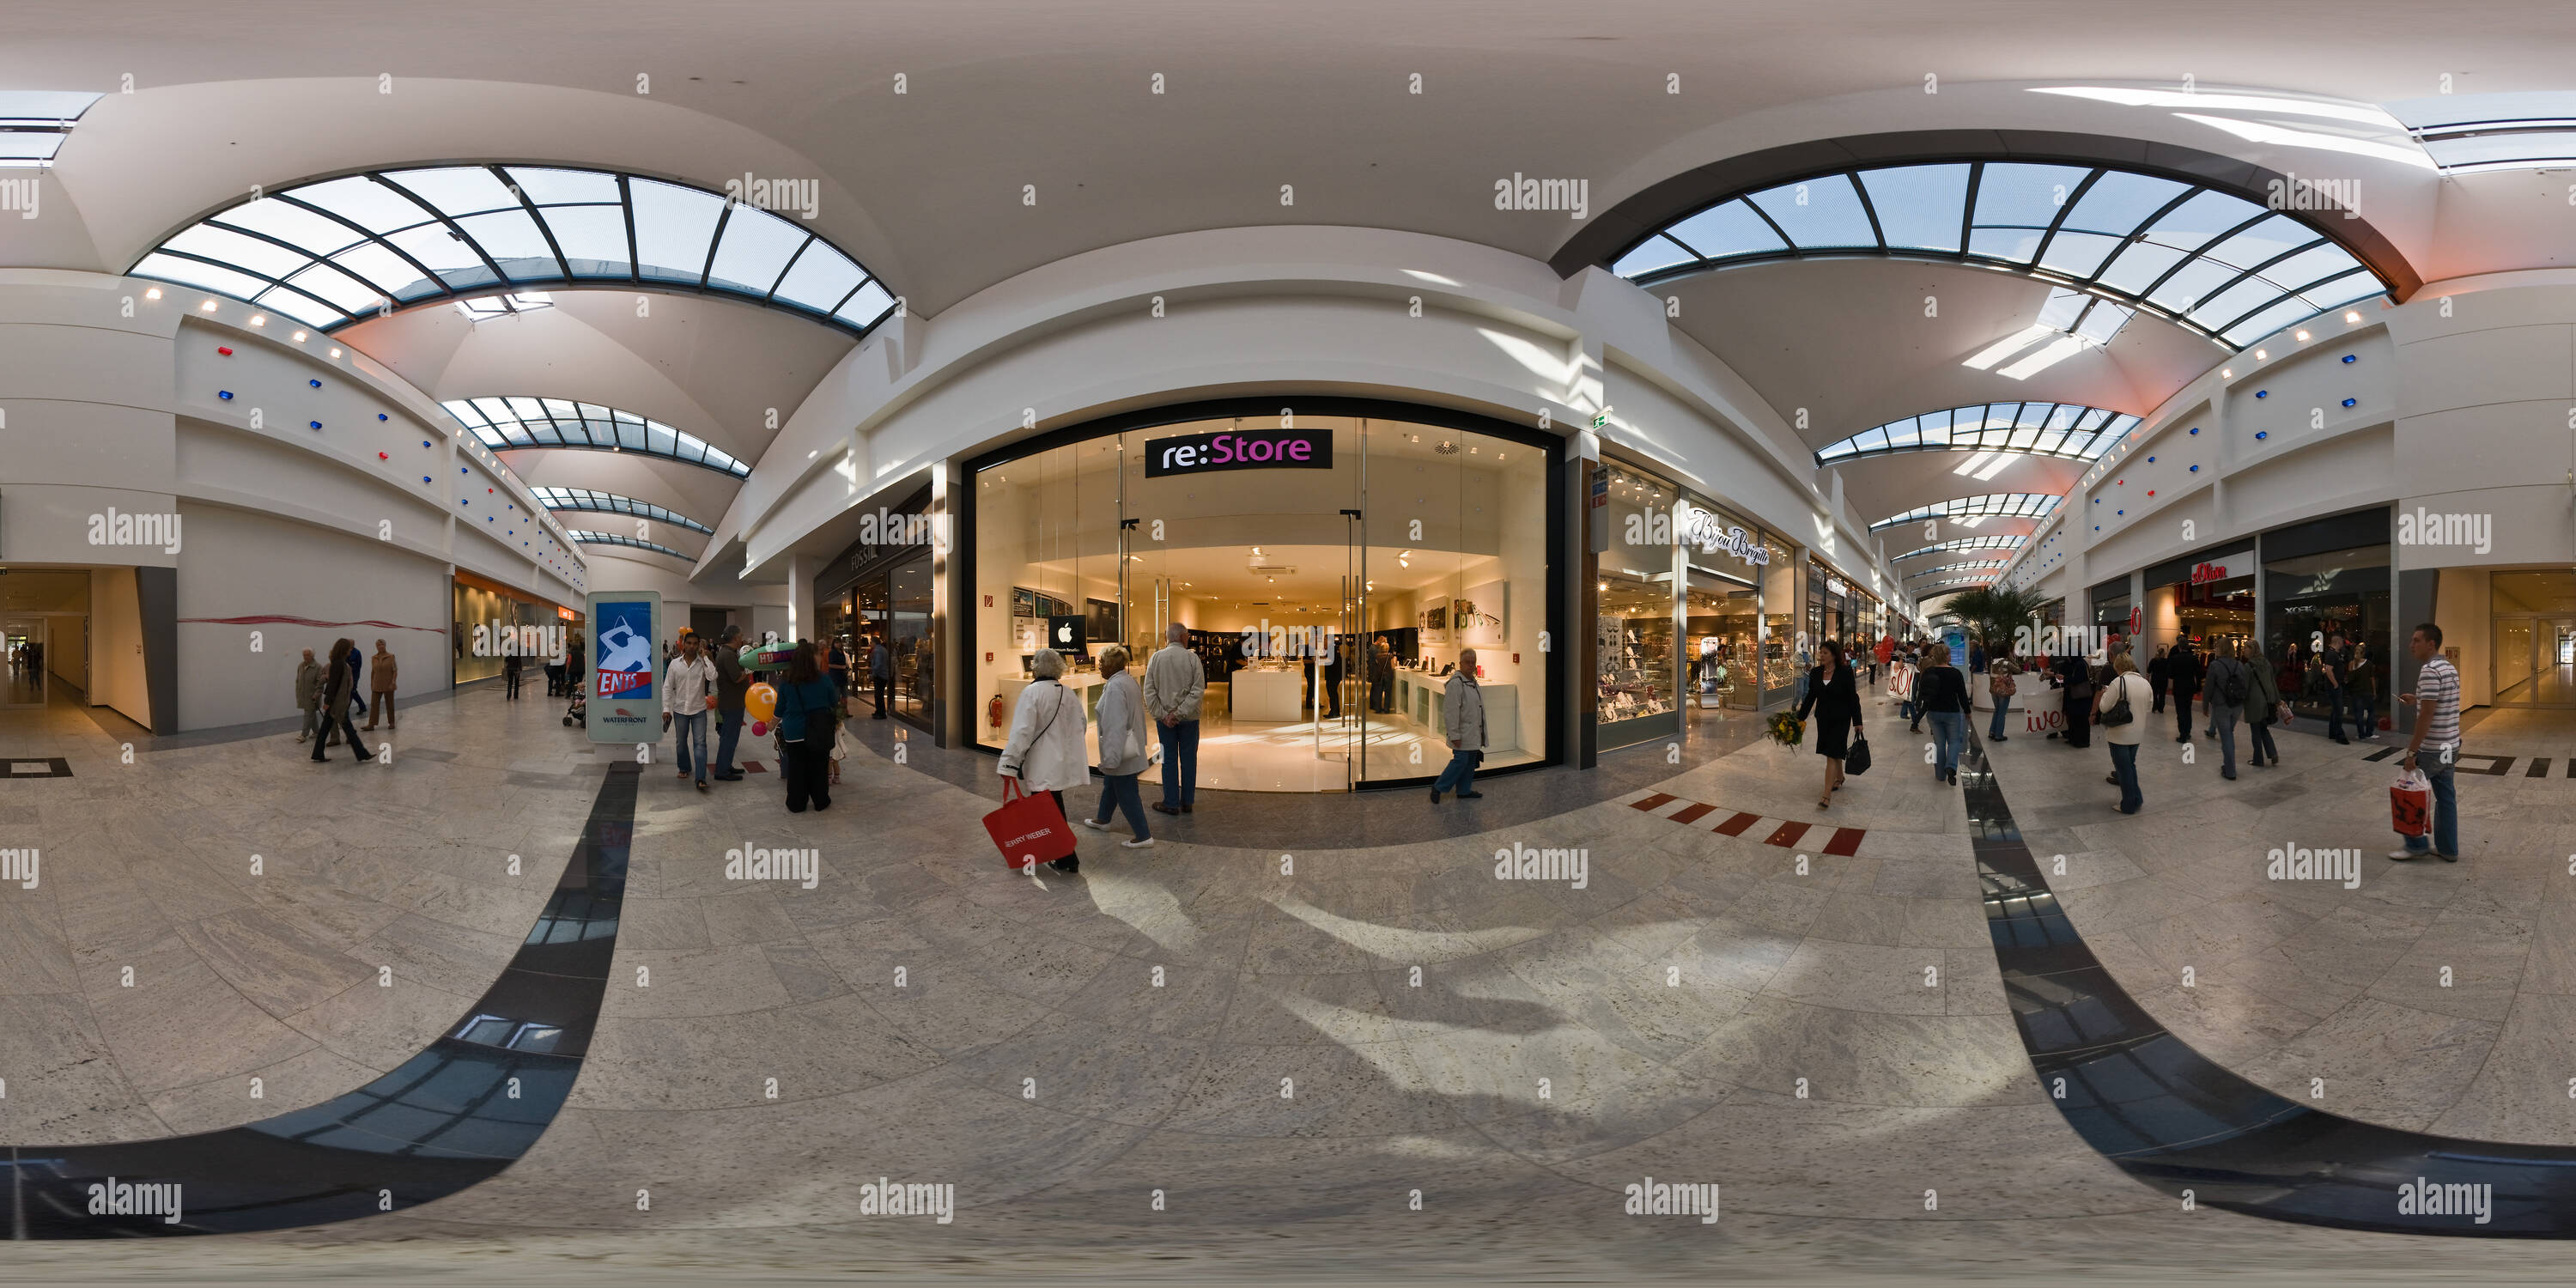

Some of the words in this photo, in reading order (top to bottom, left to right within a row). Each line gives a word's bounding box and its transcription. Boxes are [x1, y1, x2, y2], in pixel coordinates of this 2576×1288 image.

[1163, 435, 1311, 469] re:Store
[1692, 509, 1731, 548] Bijou
[1730, 527, 1769, 565] Brigitte
[852, 546, 878, 571] FOSSIL
[1025, 828, 1052, 840] WEBER
